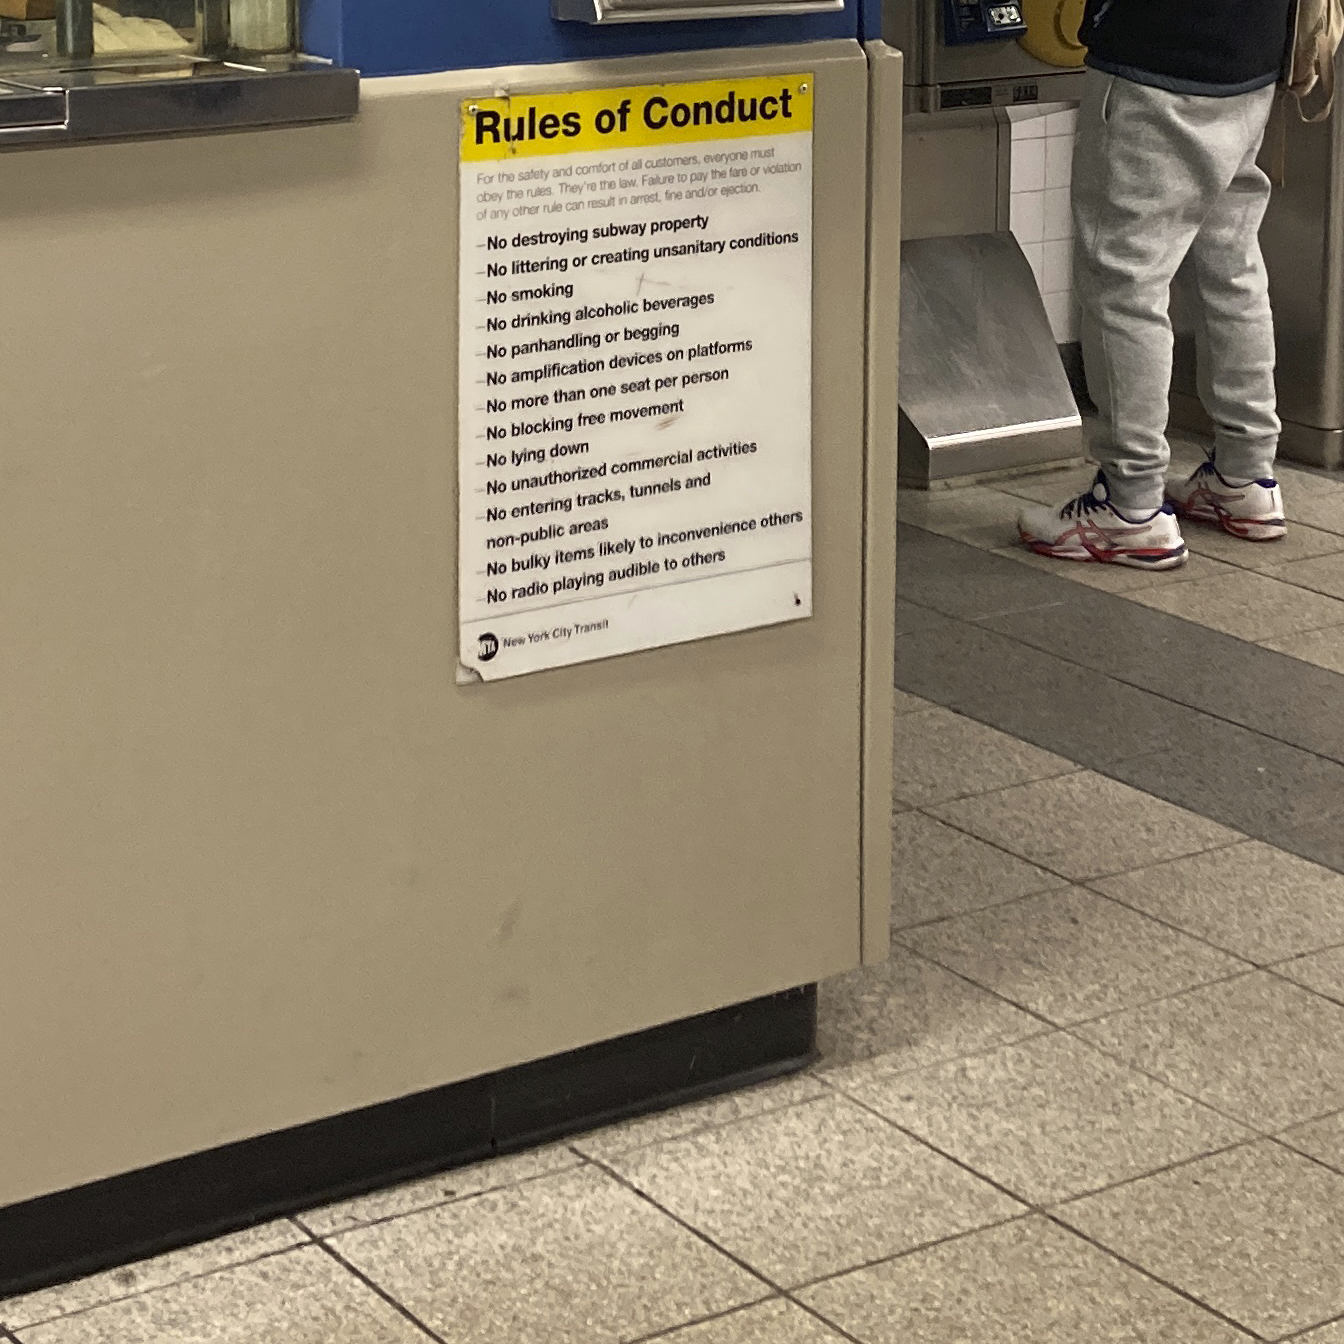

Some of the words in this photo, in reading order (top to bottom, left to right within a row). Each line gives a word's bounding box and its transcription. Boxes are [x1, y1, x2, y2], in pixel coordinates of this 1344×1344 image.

[474, 106, 582, 145] Rules
[594, 98, 631, 134] of
[642, 88, 793, 130] Conduct
[486, 234, 507, 250] No
[511, 227, 588, 247] destroying
[591, 222, 647, 239] subway
[650, 214, 709, 235] property
[486, 262, 507, 278] No
[510, 256, 568, 274] littering
[571, 255, 588, 268] or
[590, 247, 649, 265] creating
[652, 239, 726, 258] unsanitary
[728, 231, 798, 250] conditions
[485, 289, 507, 305] No
[510, 282, 574, 301] smoking
[485, 316, 507, 332] No
[510, 309, 571, 328] drinking
[574, 300, 639, 320] alcoholic
[642, 293, 714, 312] beverages
[485, 343, 507, 359] No
[510, 332, 601, 358] panhandling
[604, 330, 621, 343] or
[623, 322, 680, 341] begging
[485, 370, 507, 386] No
[510, 358, 605, 383] amplification
[608, 351, 663, 369] devices
[665, 348, 684, 361] on
[687, 339, 753, 361] platforms
[485, 398, 507, 413] No
[510, 393, 549, 410] more
[552, 388, 586, 403] than
[589, 384, 616, 398] one
[619, 376, 651, 394] seat
[653, 375, 678, 392] per
[681, 368, 729, 388] person
[486, 424, 507, 441] No
[510, 416, 573, 437] blocking
[576, 412, 606, 427] free
[609, 398, 684, 422] movement
[485, 452, 507, 468] No
[510, 447, 545, 466] lying
[548, 441, 589, 458] down
[486, 479, 507, 495] No
[510, 462, 607, 491] unauthorized
[609, 448, 692, 474] commercial
[696, 441, 757, 461] activities
[486, 506, 507, 522] No
[510, 497, 572, 518] entering
[575, 488, 625, 507] tracks,
[628, 477, 681, 498] tunnels
[684, 471, 711, 489] and
[485, 560, 507, 577] No
[510, 553, 551, 572] bulky
[554, 547, 595, 564] items
[598, 538, 636, 557] likely
[638, 535, 653, 549] to
[656, 519, 757, 546] inconvenience
[759, 511, 803, 528] others
[486, 524, 565, 549] non-public
[568, 517, 609, 535] areas
[486, 587, 507, 604] No
[510, 580, 548, 599] radio
[552, 571, 604, 595] playing
[607, 560, 660, 581] audible
[663, 557, 678, 571] to
[681, 550, 726, 568] others
